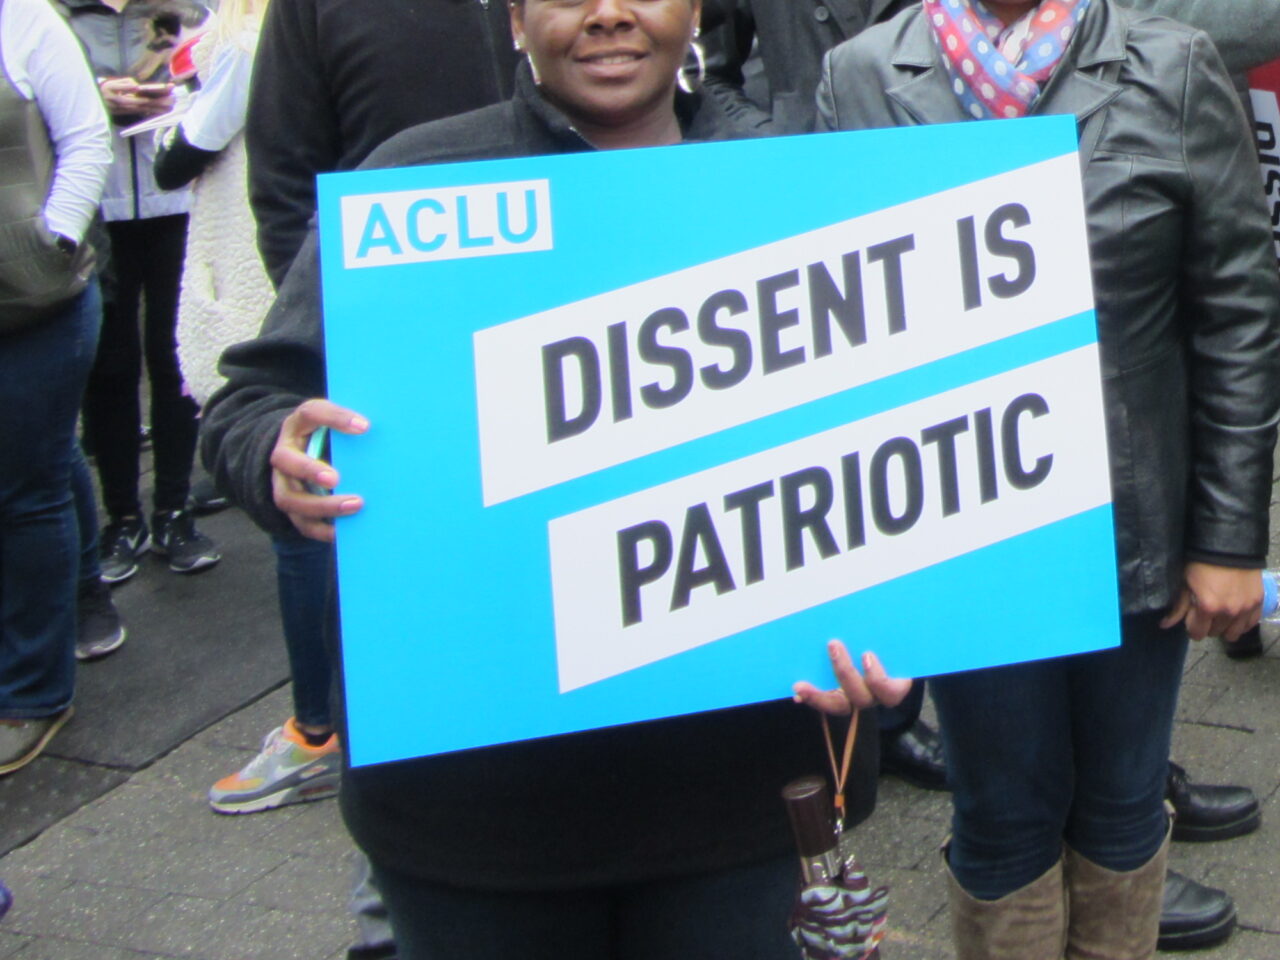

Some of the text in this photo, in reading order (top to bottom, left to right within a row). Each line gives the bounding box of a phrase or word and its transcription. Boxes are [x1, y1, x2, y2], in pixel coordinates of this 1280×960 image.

[356, 189, 538, 258] ACLU
[540, 202, 1037, 444] DISSENT IS
[615, 393, 1054, 629] PATRIOTIC
